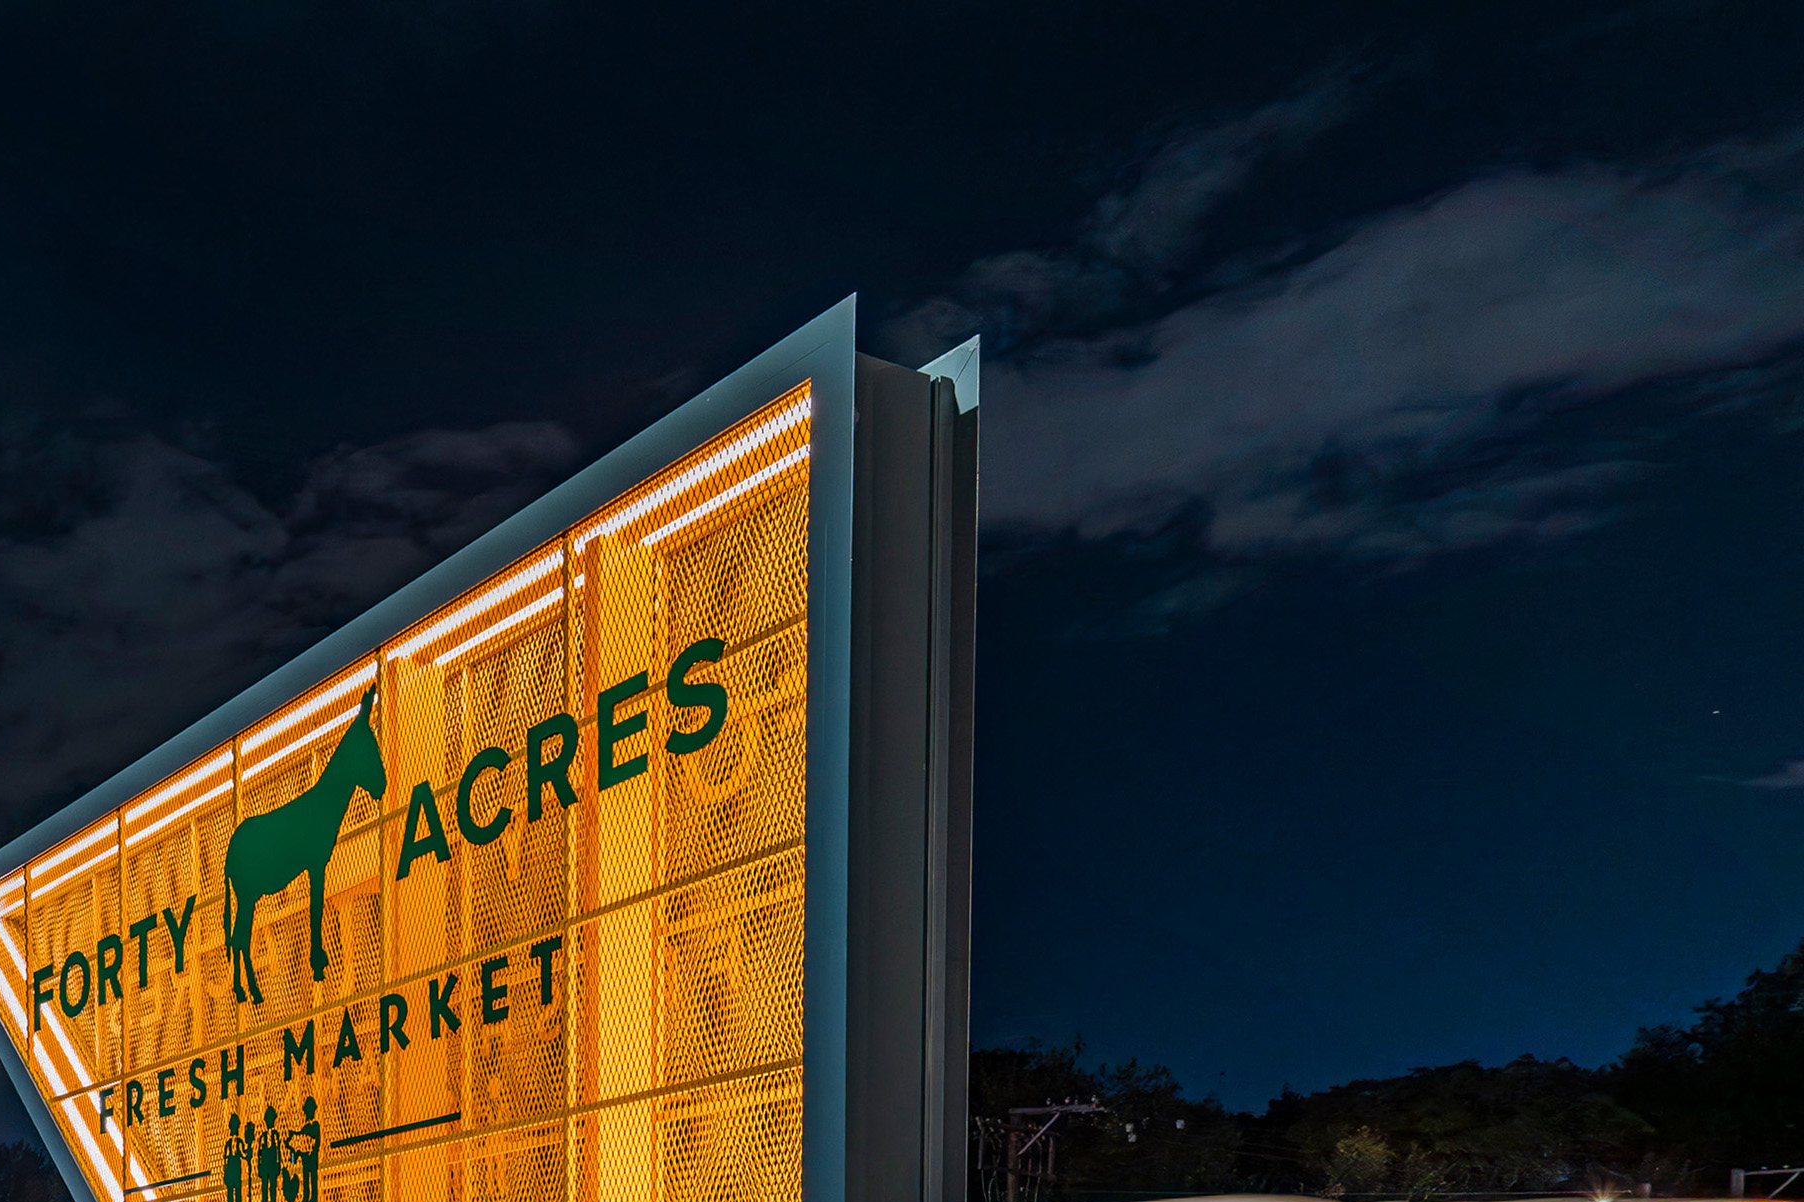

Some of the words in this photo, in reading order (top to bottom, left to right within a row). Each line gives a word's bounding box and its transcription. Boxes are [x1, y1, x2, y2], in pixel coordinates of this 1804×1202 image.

[33, 894, 196, 1032] FORTY
[396, 637, 728, 881] ACRES
[100, 1045, 244, 1135] FRESH
[283, 936, 562, 1081] MARKET
